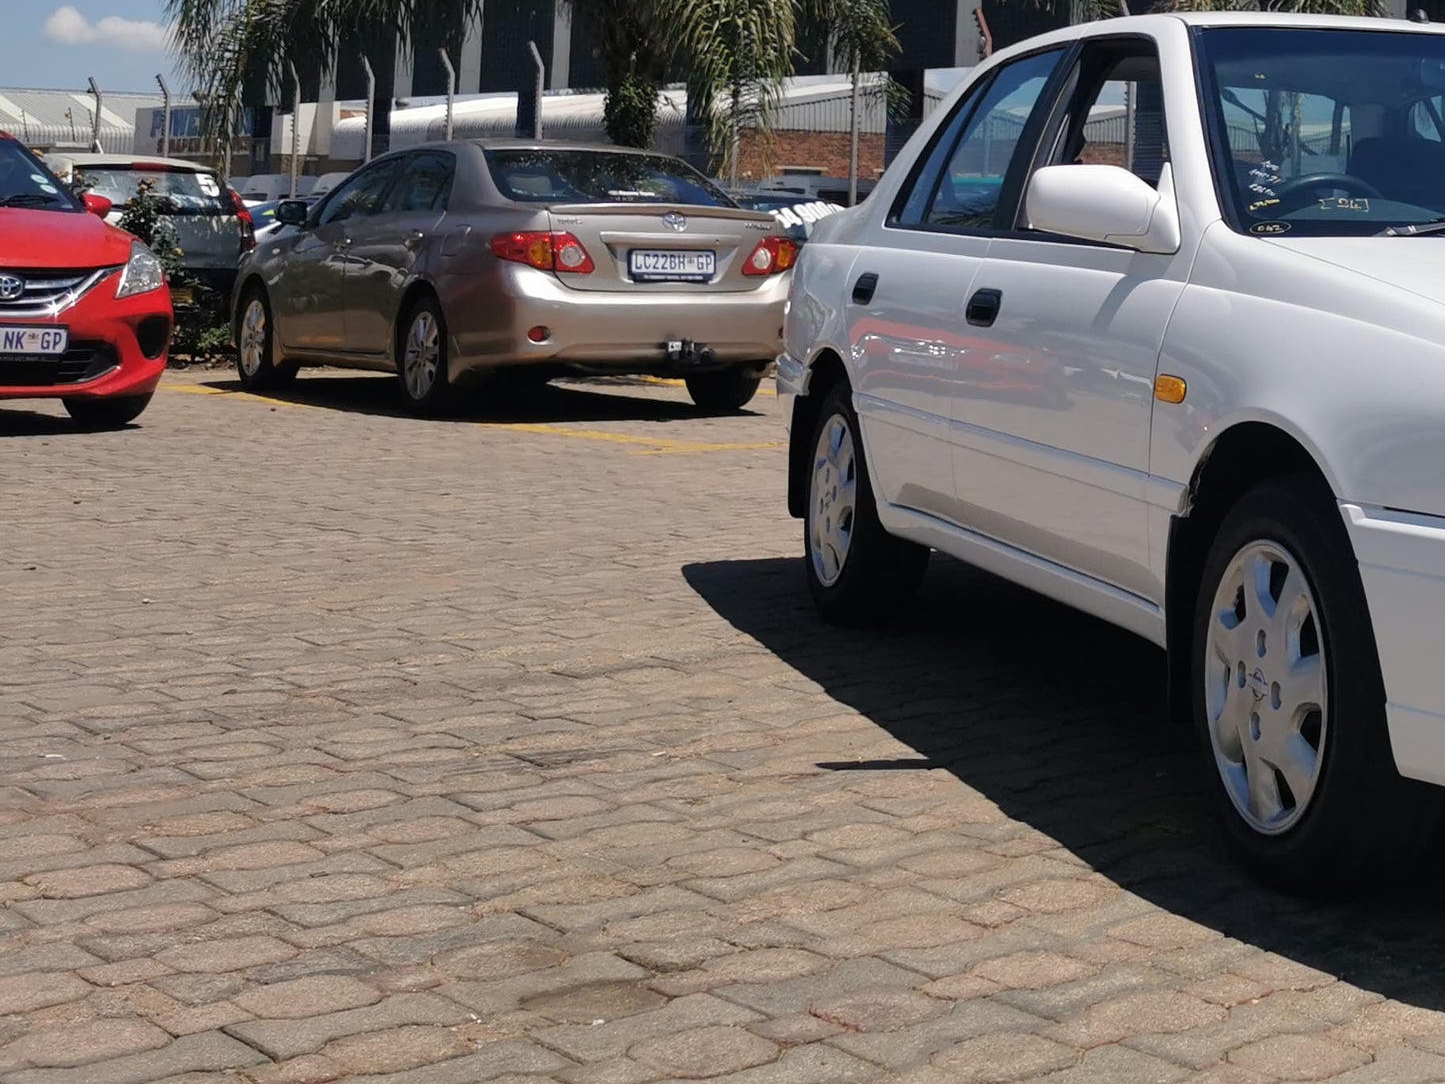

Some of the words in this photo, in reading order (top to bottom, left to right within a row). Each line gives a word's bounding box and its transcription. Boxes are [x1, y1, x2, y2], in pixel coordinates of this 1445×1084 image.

[635, 253, 685, 270] LC22BH
[696, 254, 712, 270] GP
[3, 331, 26, 350] NK
[40, 332, 62, 350] GP
